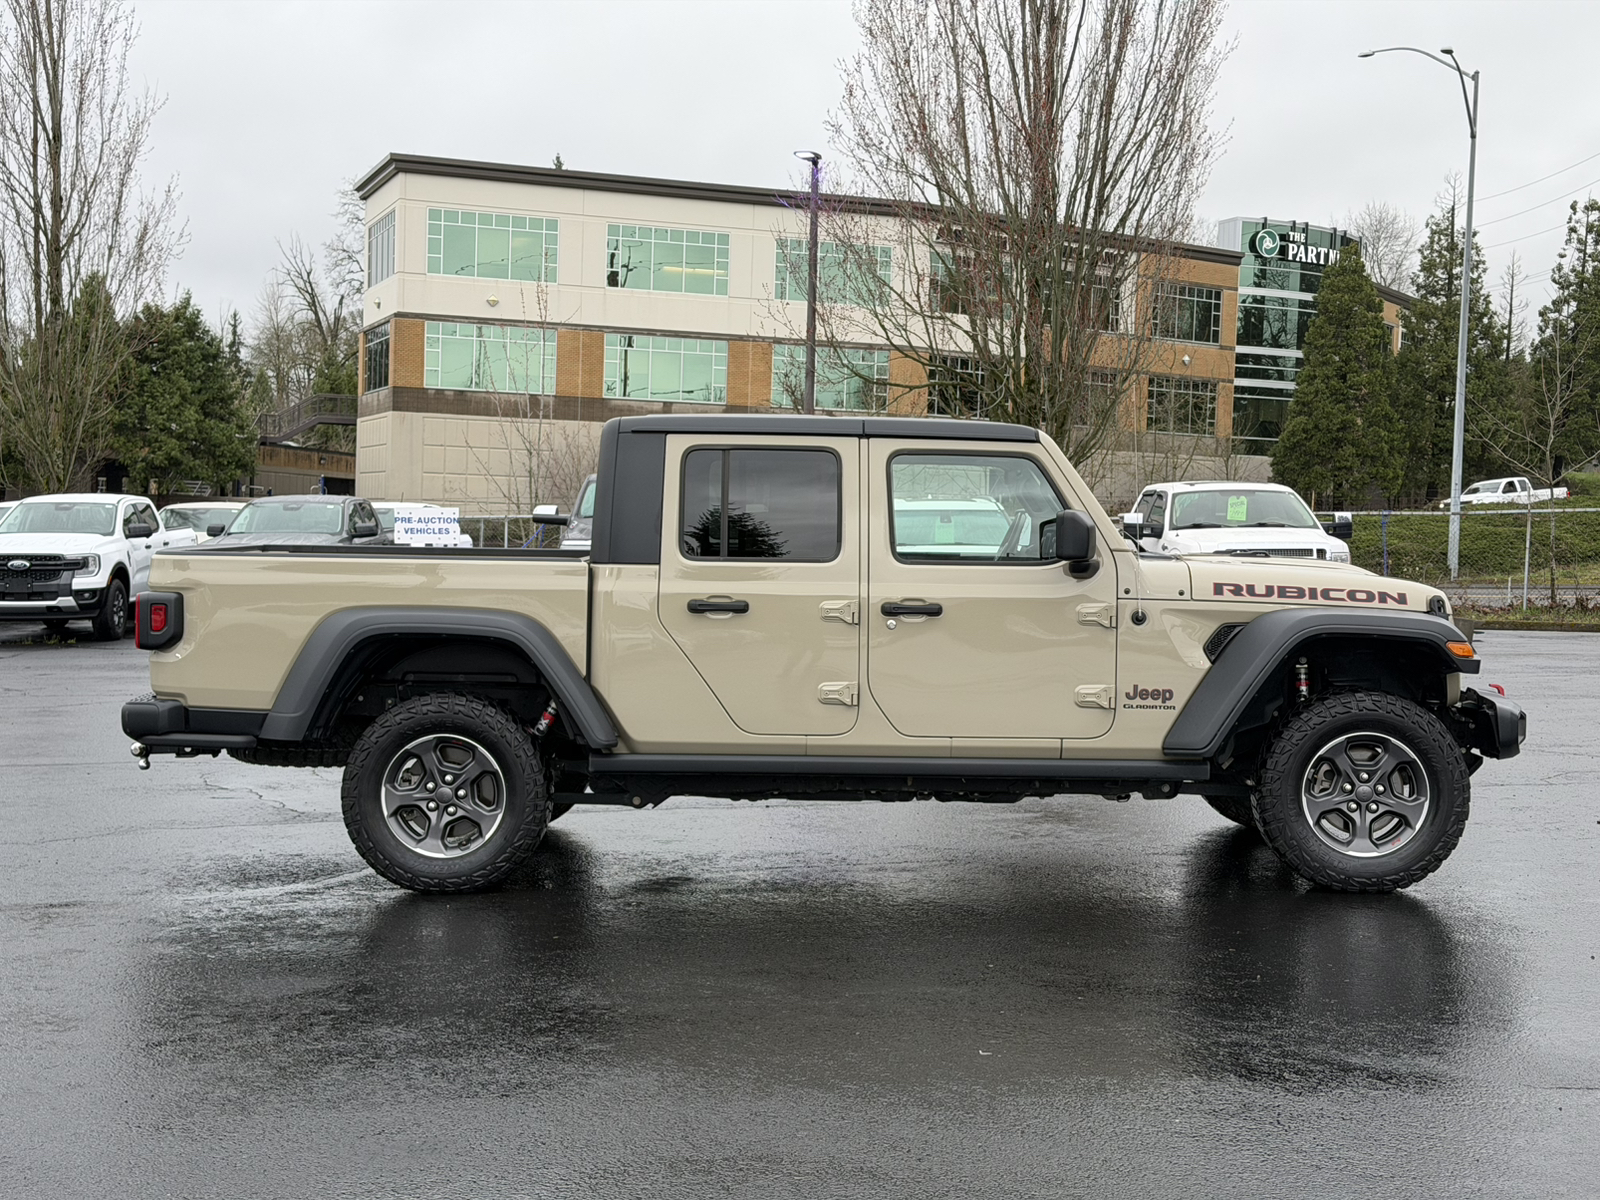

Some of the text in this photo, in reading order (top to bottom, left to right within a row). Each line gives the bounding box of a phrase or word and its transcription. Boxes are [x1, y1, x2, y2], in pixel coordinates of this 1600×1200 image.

[1288, 231, 1306, 242] THE
[394, 516, 460, 524] PRE-AUCTION
[403, 527, 450, 535] VEHICLES
[1213, 582, 1408, 605] RUBICON
[1125, 684, 1174, 704] Jeep
